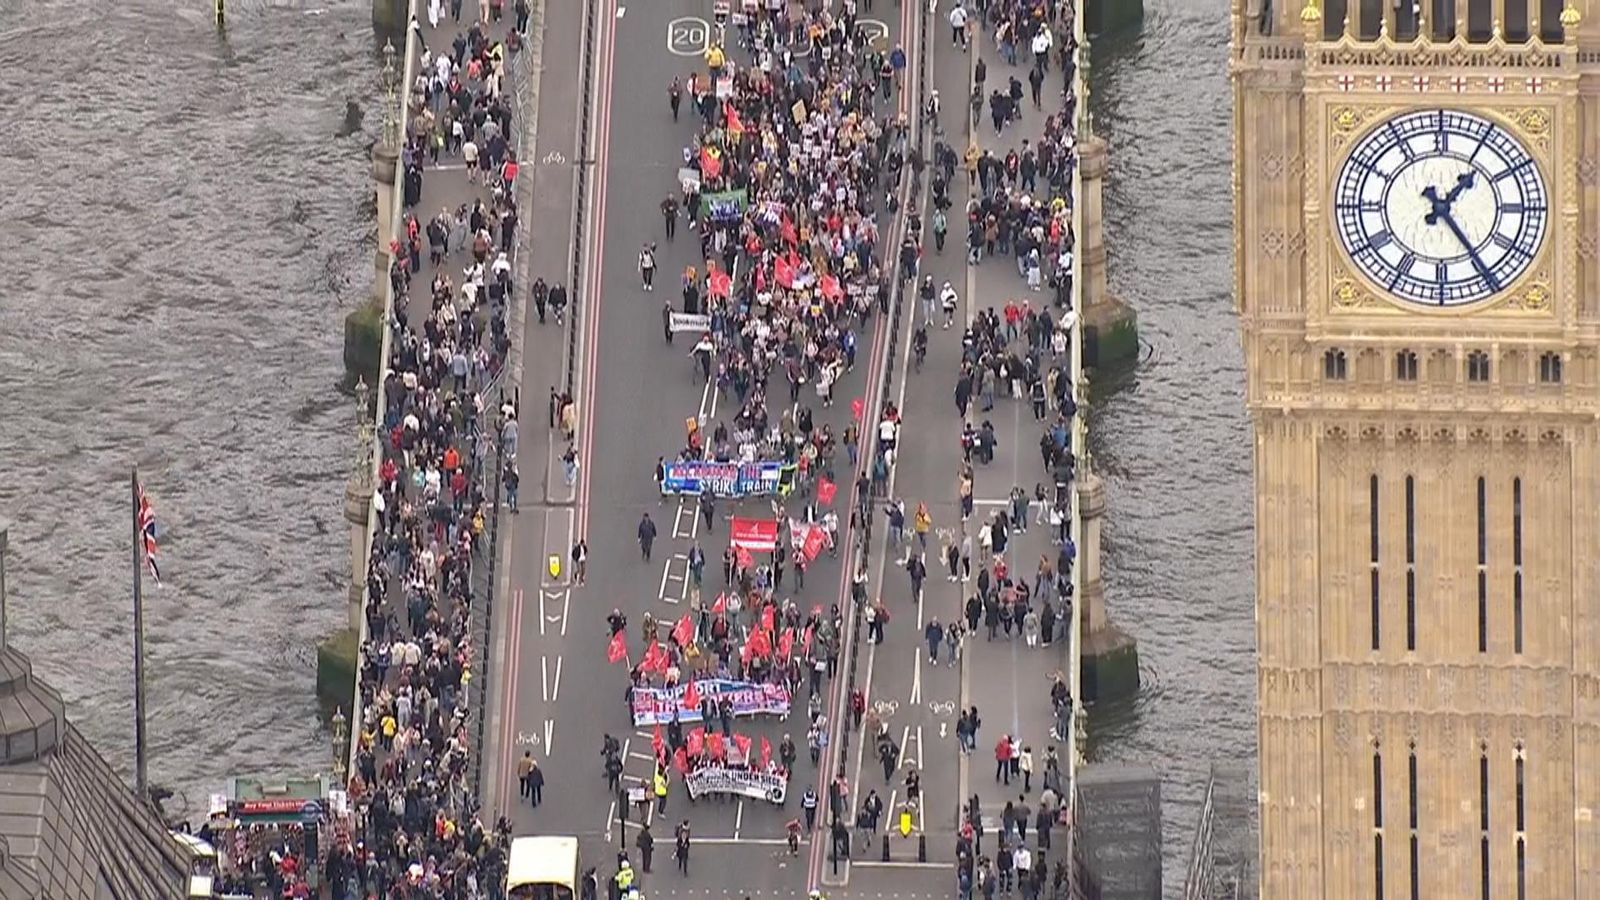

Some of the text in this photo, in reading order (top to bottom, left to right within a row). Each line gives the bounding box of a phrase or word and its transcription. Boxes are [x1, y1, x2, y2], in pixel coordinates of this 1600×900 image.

[674, 28, 704, 45] 20
[742, 479, 772, 493] TRAIN
[656, 683, 720, 700] SUPORT
[732, 771, 760, 783] UNDER
